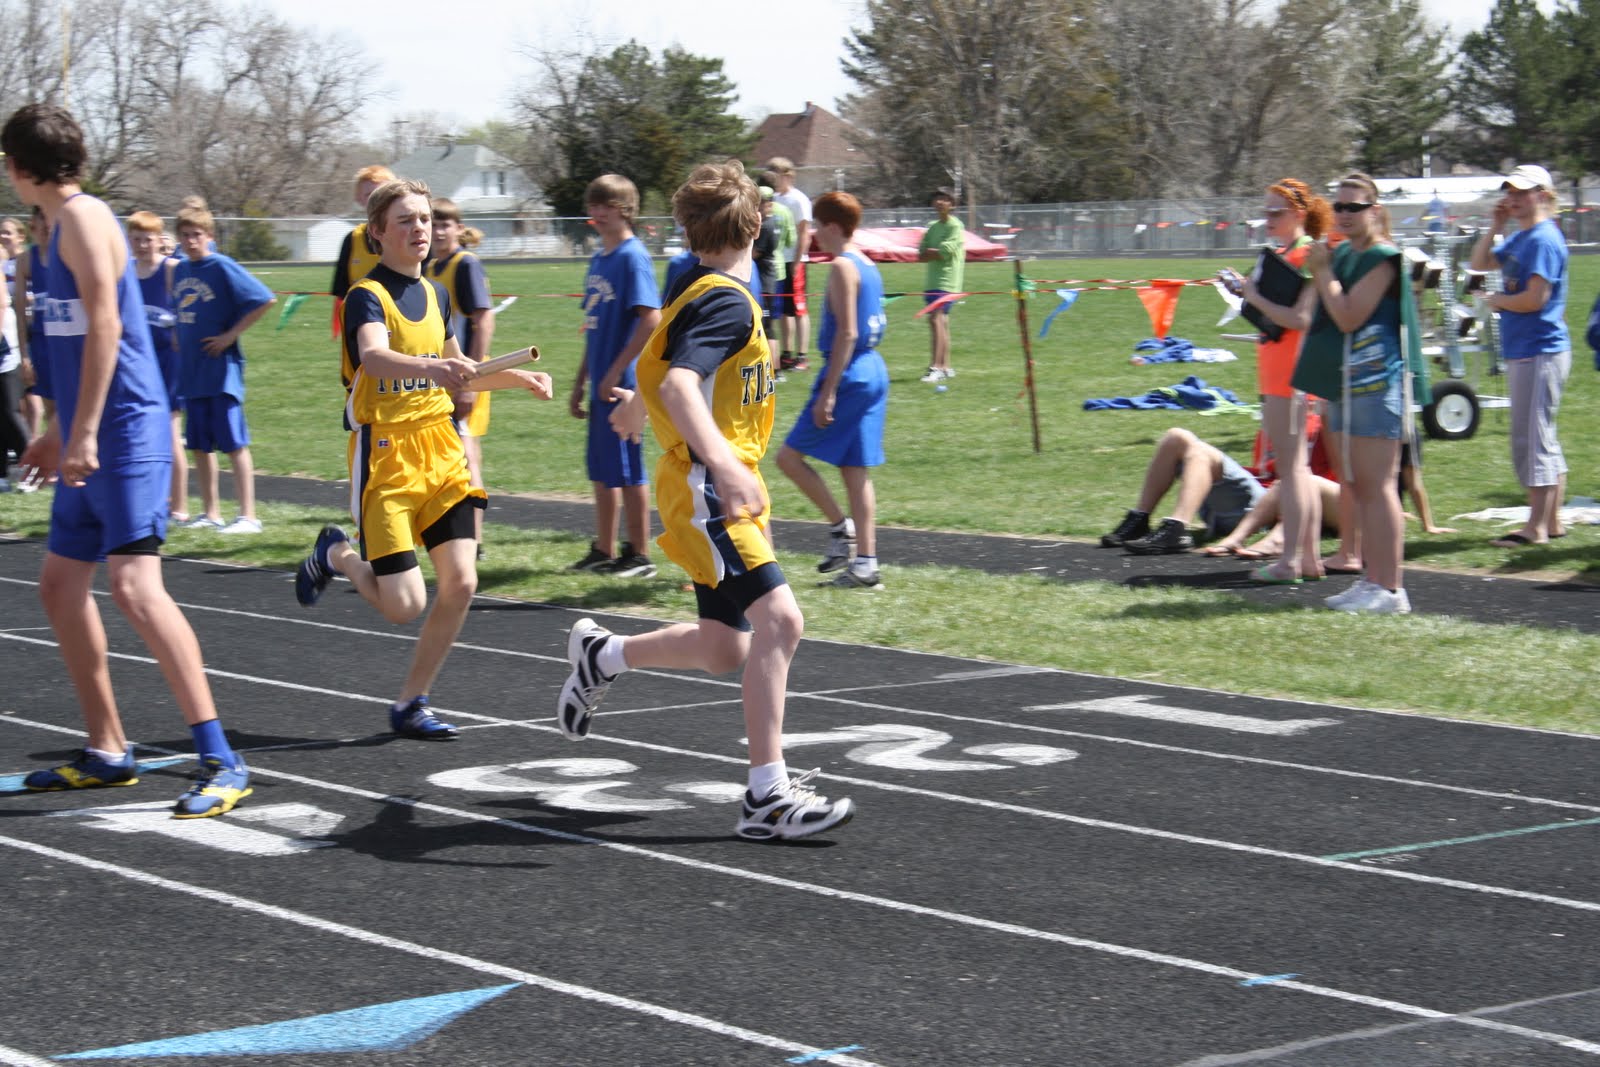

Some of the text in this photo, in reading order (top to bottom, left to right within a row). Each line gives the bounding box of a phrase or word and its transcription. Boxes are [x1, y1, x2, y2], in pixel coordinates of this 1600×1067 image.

[1021, 694, 1344, 737] 1
[738, 723, 1080, 772] 2
[426, 757, 748, 812] 3
[47, 800, 347, 857] 4
